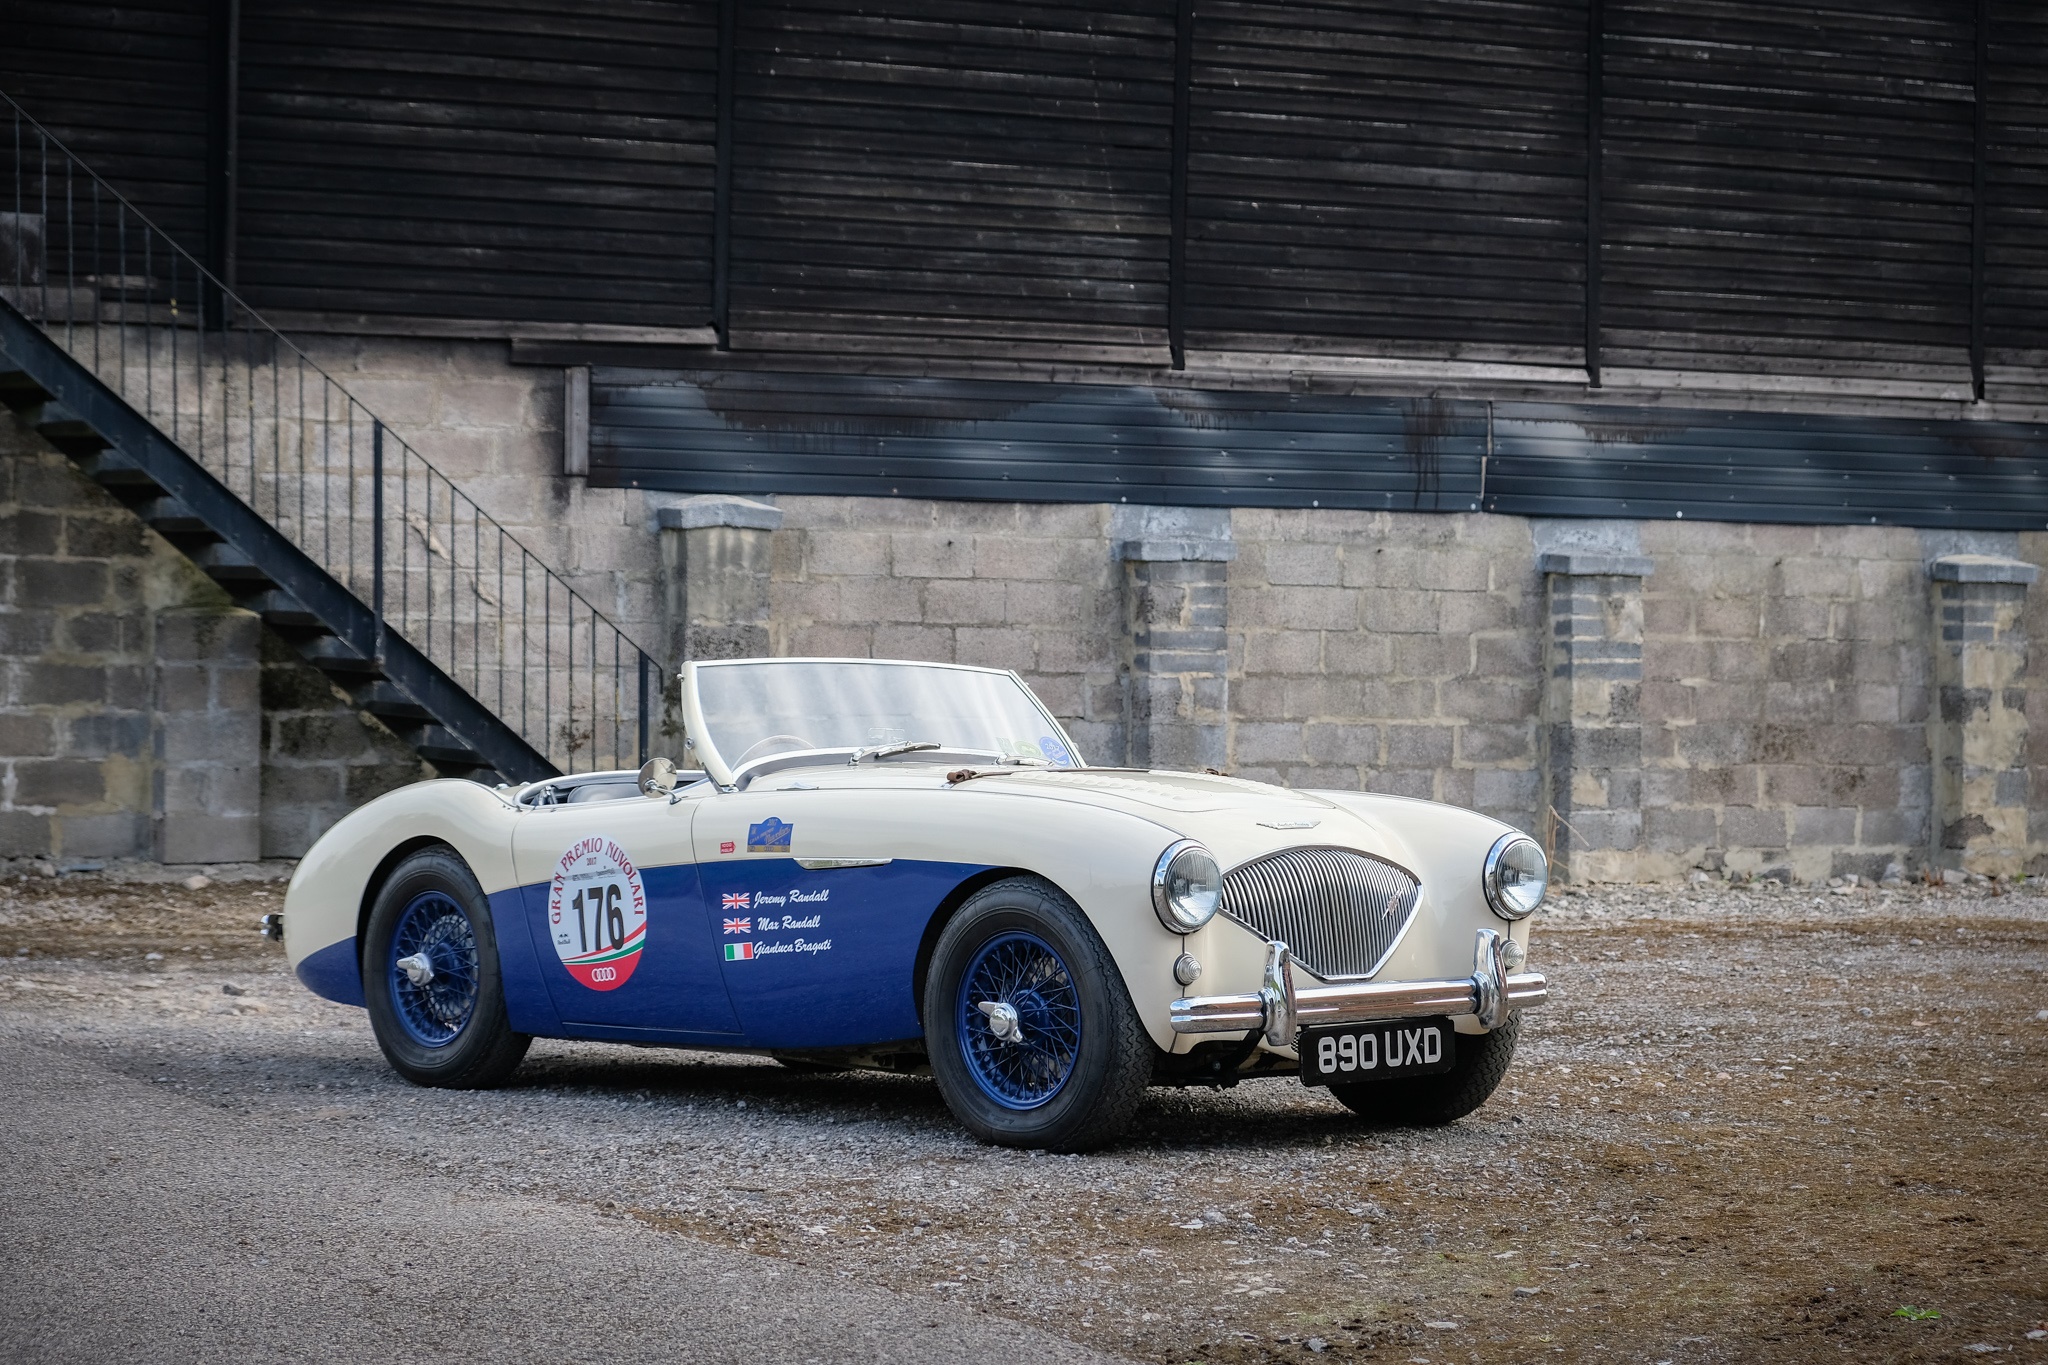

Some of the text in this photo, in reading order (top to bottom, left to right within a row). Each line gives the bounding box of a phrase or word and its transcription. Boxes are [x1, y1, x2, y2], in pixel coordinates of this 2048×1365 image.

[586, 857, 597, 866] 2017
[552, 837, 644, 925] GRAN PREMIO NUVOLARI
[754, 889, 829, 908] Jeremy Randall
[572, 884, 625, 952] 176
[758, 915, 820, 931] Max Randall
[754, 938, 832, 959] Gianluca Braguti
[1318, 1027, 1442, 1074] 890 UXD
